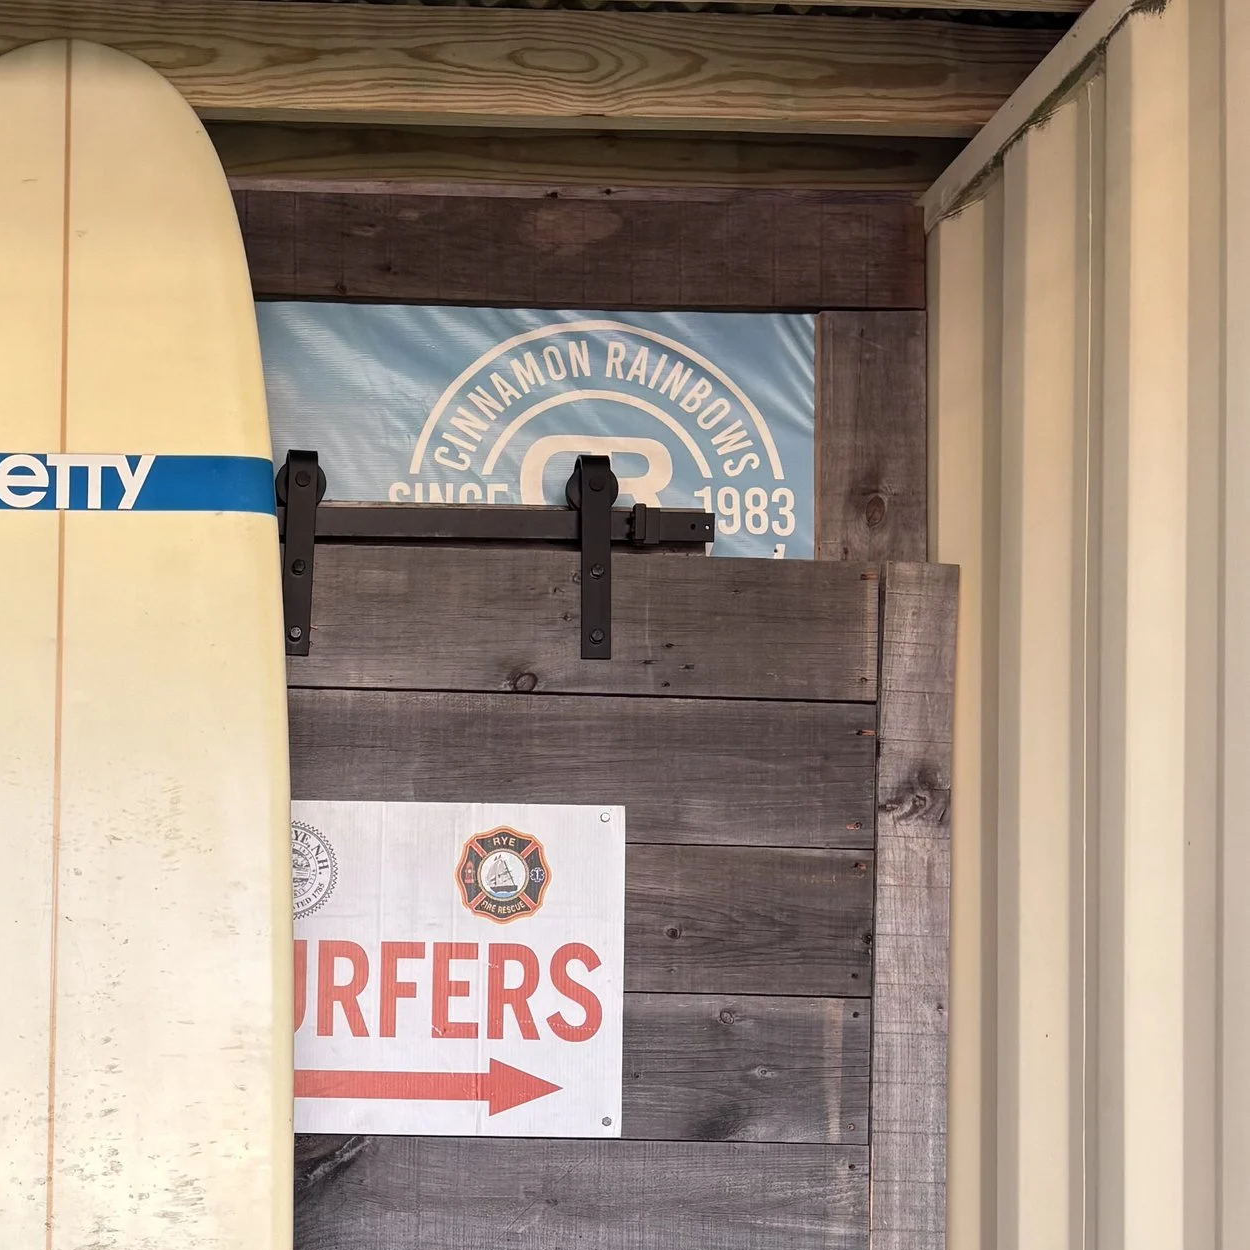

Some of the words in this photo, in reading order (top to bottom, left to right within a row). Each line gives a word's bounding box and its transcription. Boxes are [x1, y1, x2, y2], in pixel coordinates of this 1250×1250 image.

[433, 340, 591, 471] CINNAMON
[605, 341, 760, 477] RAINBOWS
[693, 486, 796, 537] 1983
[492, 836, 516, 847] RYE
[480, 900, 496, 912] FIRE
[497, 901, 526, 914] RESCUE
